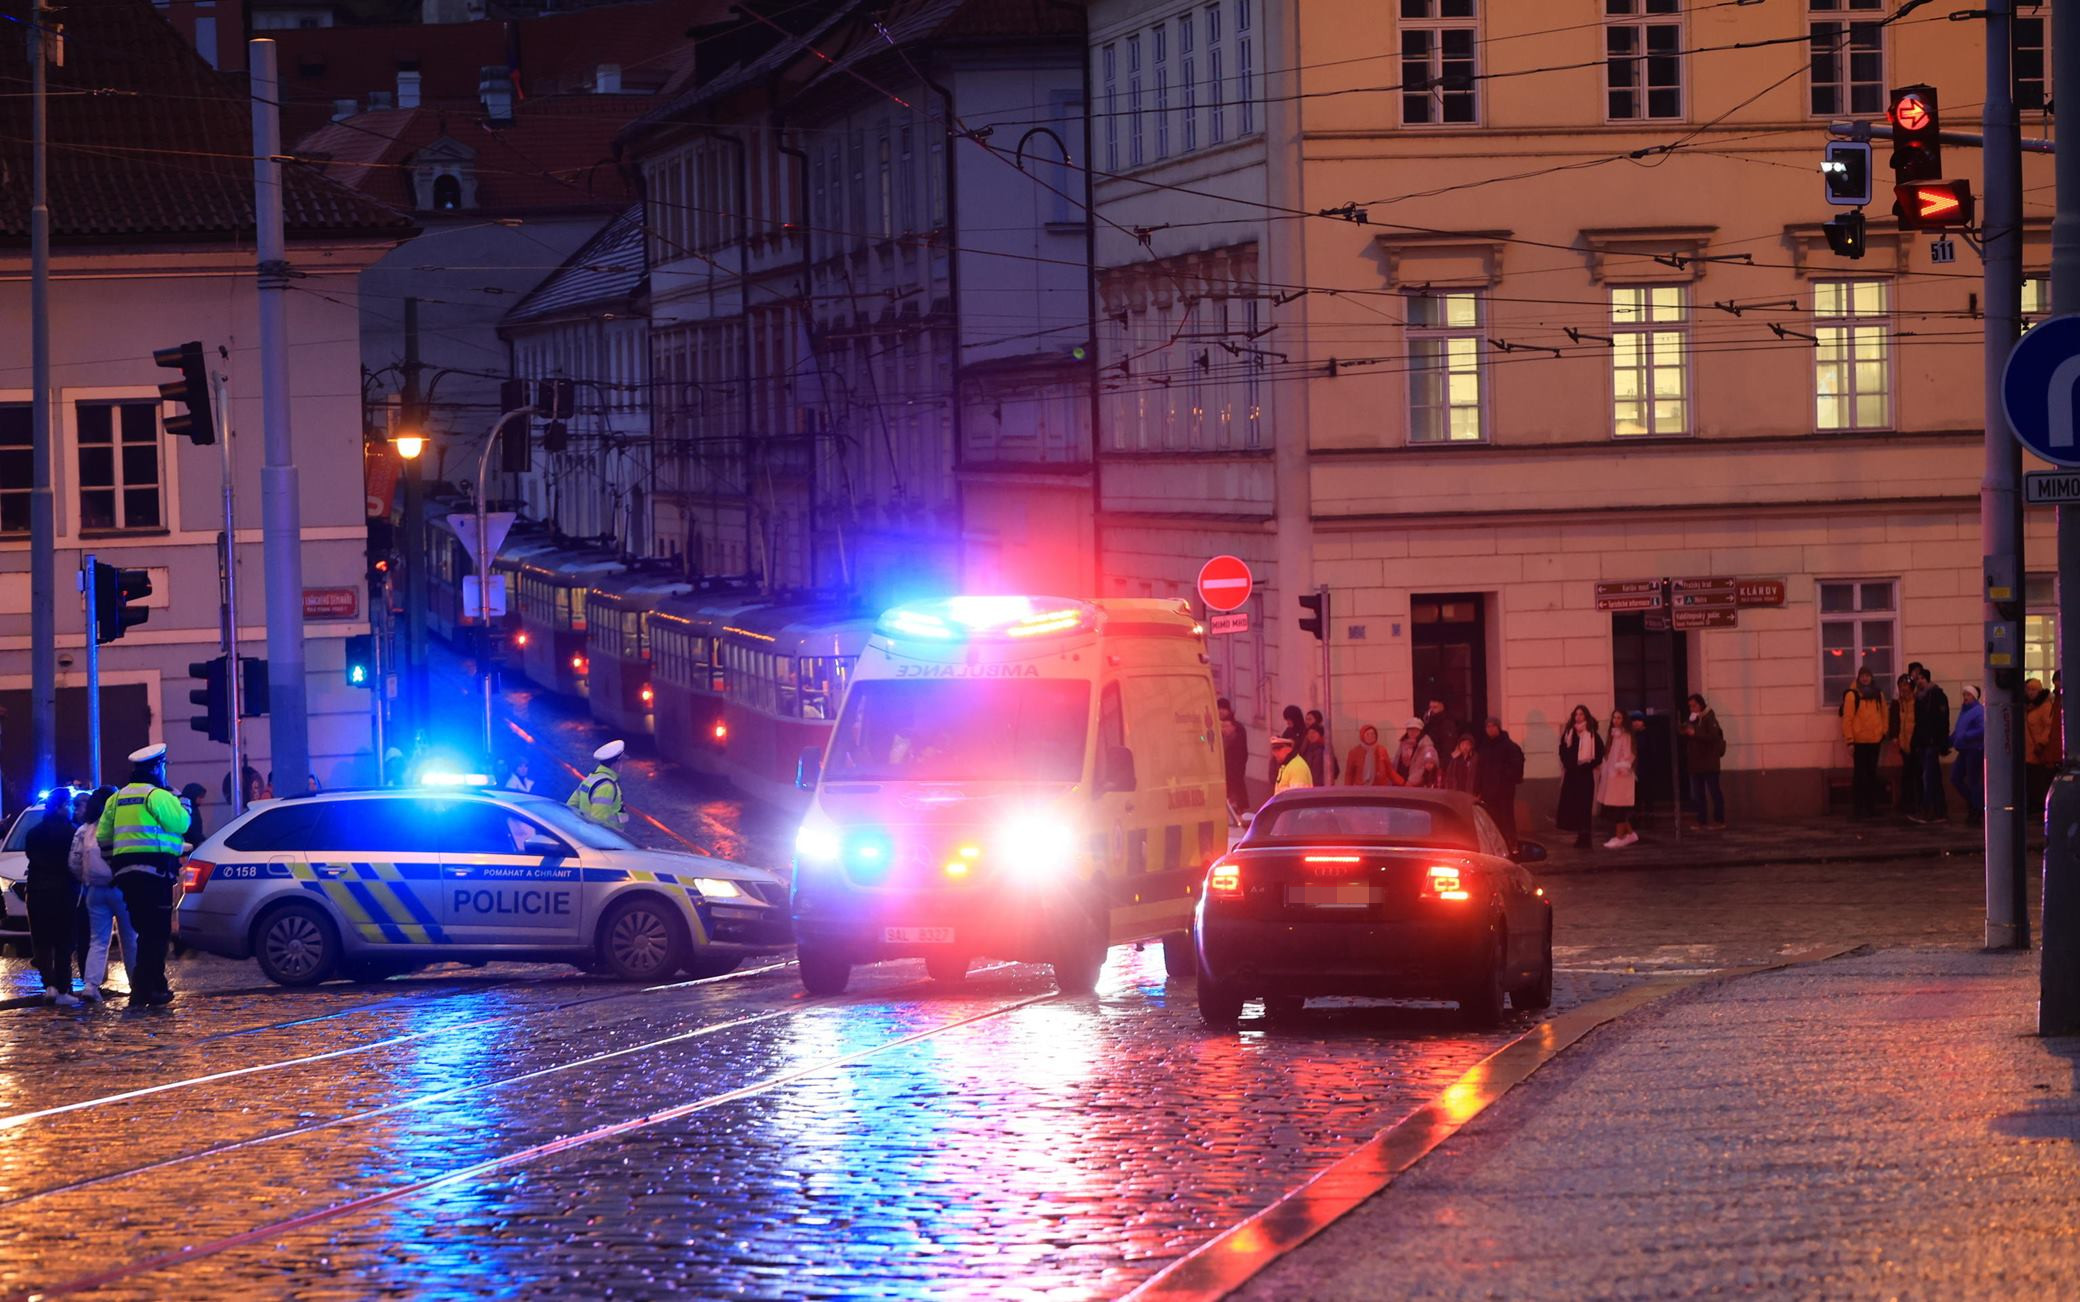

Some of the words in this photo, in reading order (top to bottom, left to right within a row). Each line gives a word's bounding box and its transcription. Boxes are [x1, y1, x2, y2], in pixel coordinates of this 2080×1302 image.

[1931, 242, 1953, 260] 511
[2038, 478, 2080, 498] MIMO
[1740, 585, 1777, 597] KLÁROV
[236, 866, 257, 877] 158
[483, 868, 525, 877] POMÁHAT
[526, 869, 532, 877] A
[534, 868, 572, 878] CHRÁNIT
[453, 889, 571, 914] POLICIE
